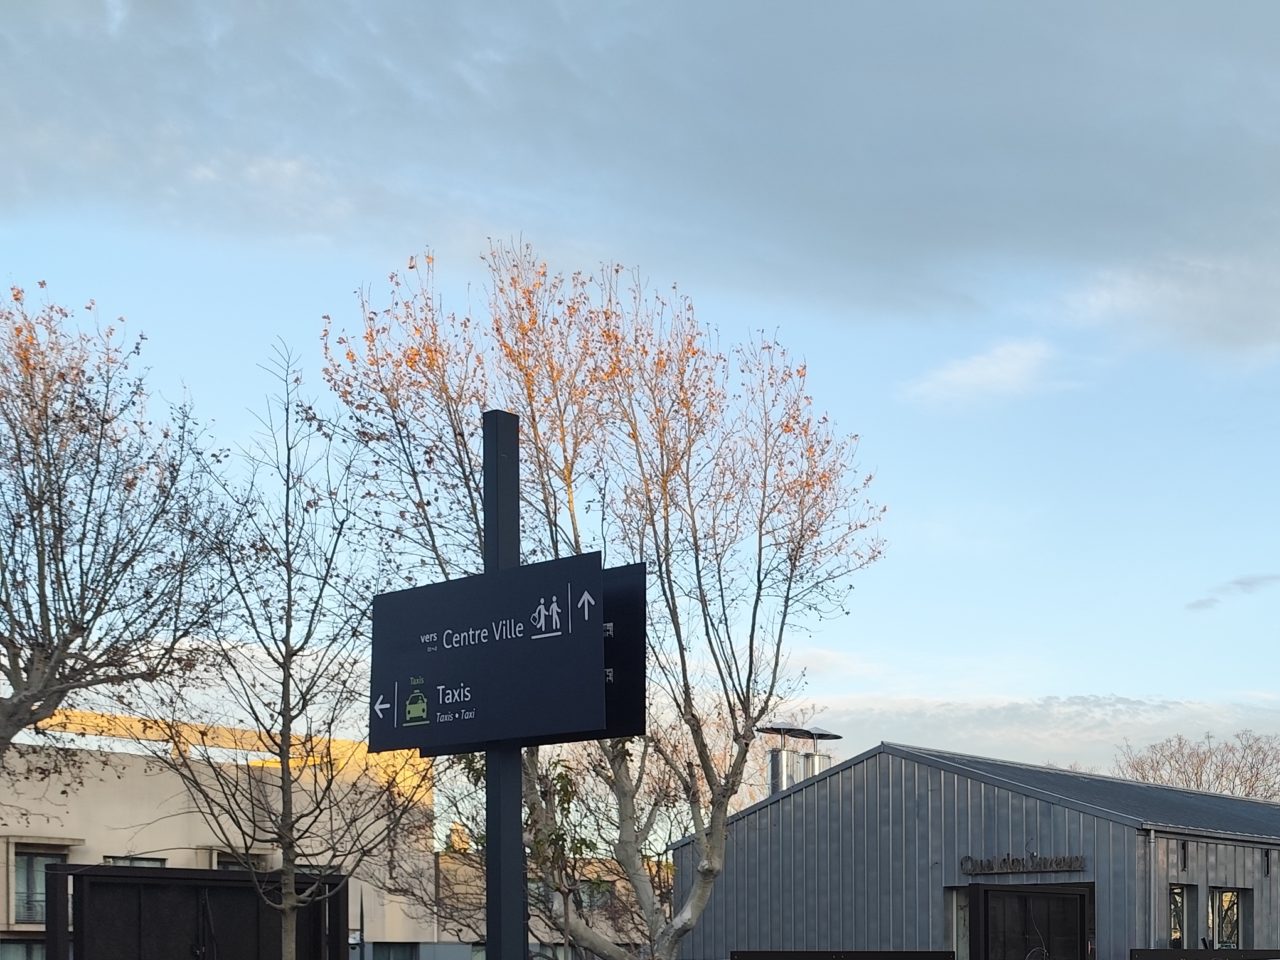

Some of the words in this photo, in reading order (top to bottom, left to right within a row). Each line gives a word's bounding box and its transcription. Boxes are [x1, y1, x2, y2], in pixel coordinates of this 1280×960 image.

[420, 632, 438, 643] vers
[443, 627, 489, 649] Centre
[492, 618, 524, 640] Ville
[410, 676, 425, 685] Taxis
[437, 683, 471, 704] Taxis
[436, 711, 454, 723] Taxis
[460, 708, 476, 720] Taxi
